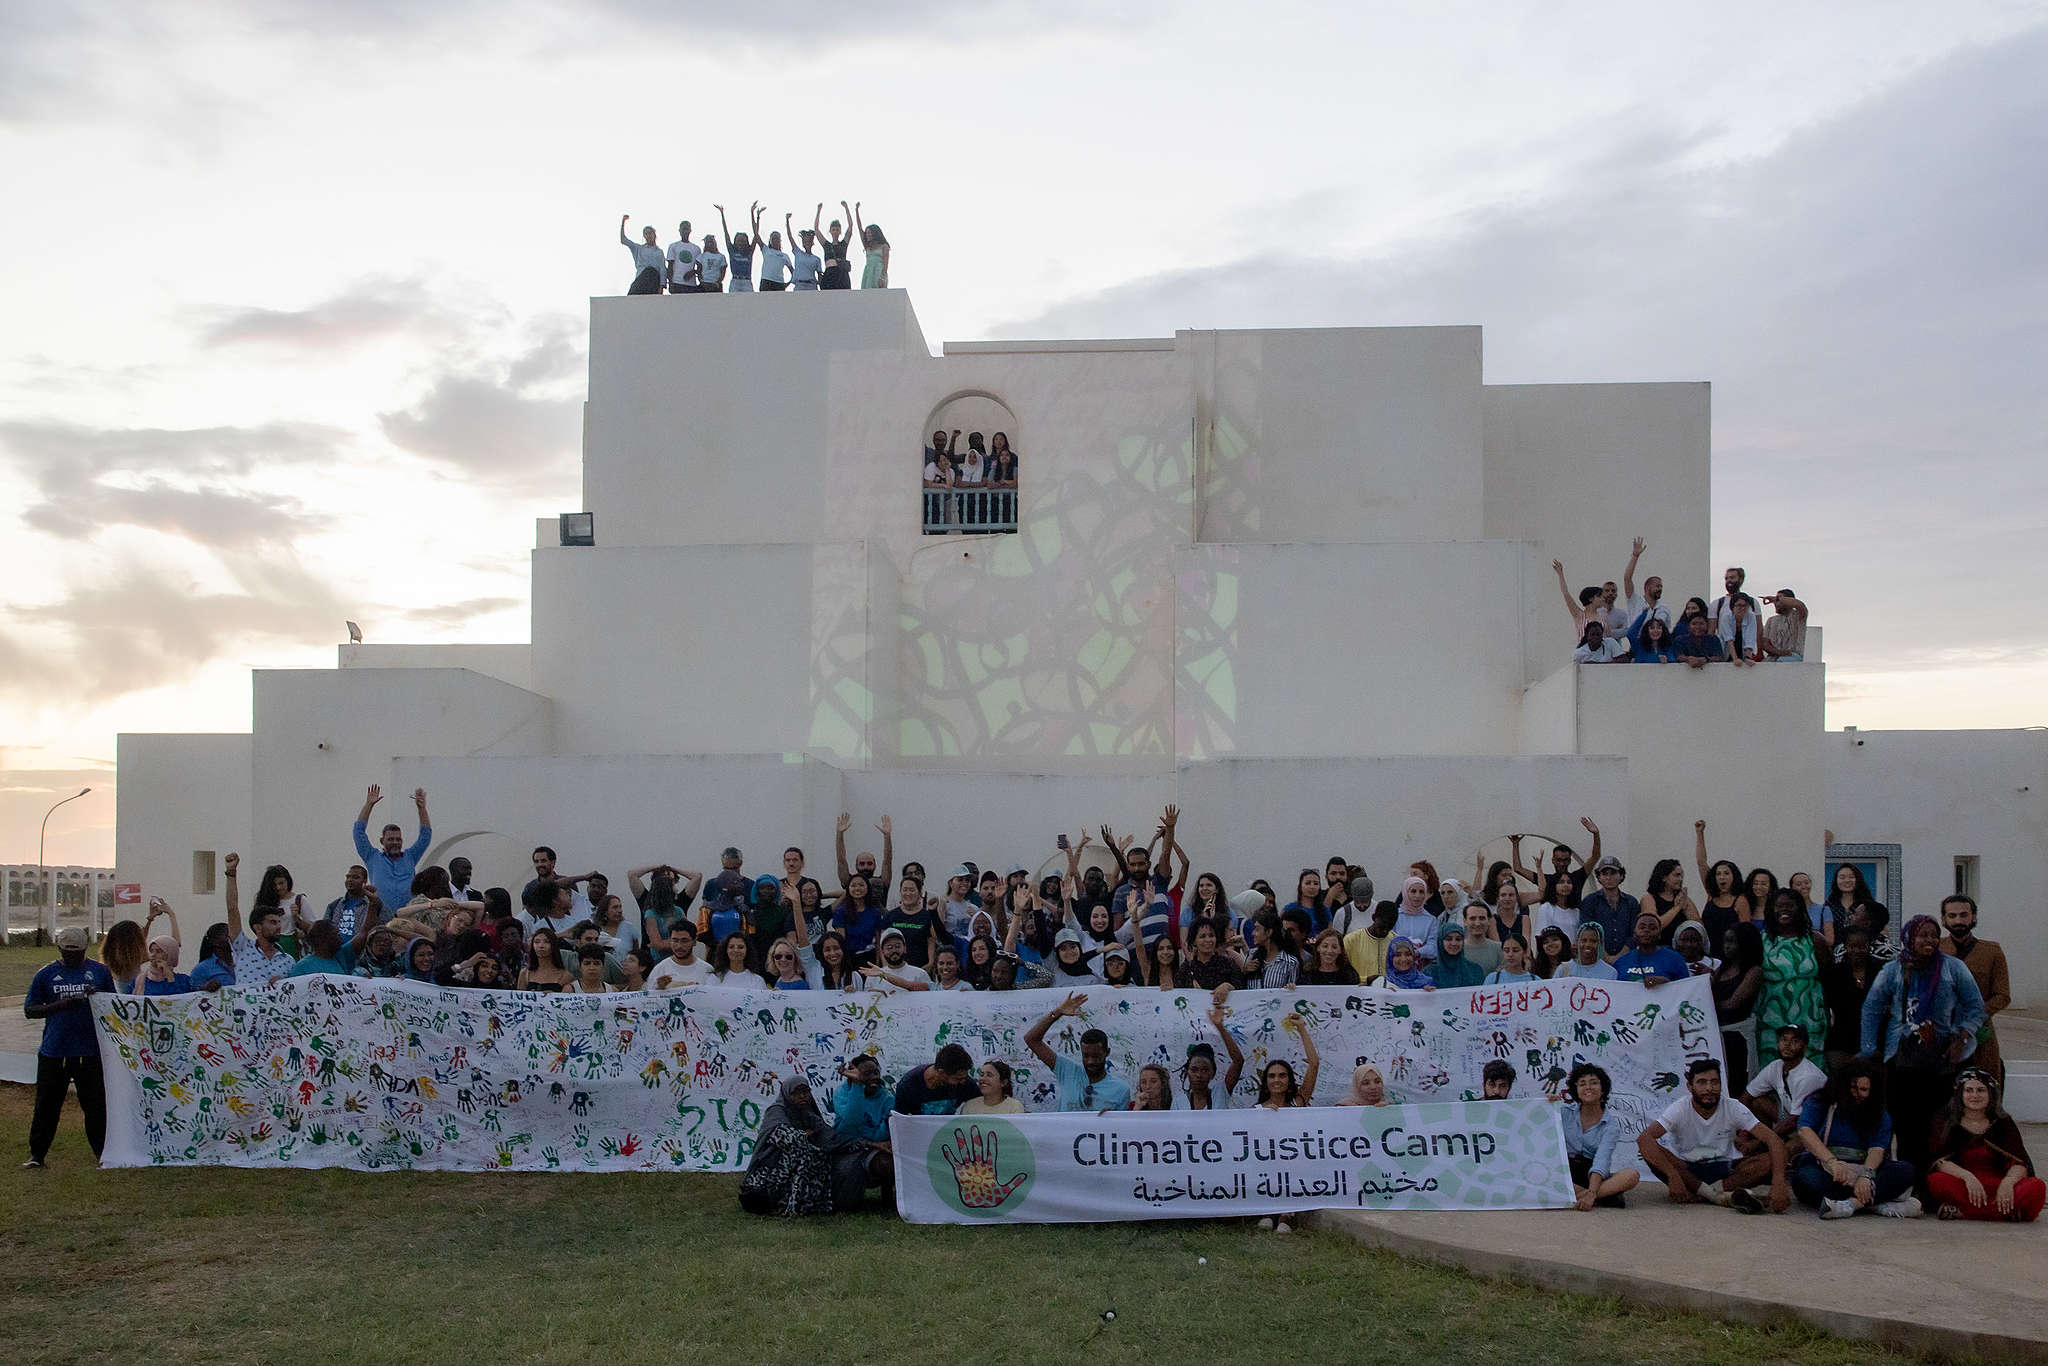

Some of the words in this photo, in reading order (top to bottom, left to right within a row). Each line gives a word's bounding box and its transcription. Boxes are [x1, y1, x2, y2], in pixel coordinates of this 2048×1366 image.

[53, 983, 90, 994] Emirat
[1470, 985, 1554, 1016] GREEN
[112, 997, 161, 1023] VCA
[677, 1095, 760, 1136] STO
[1073, 1132, 1223, 1167] Climate
[1232, 1130, 1372, 1162] Justice
[1380, 1127, 1496, 1164] Camp
[1133, 1172, 1247, 1207] المناخية
[1256, 1170, 1347, 1200] العدالة
[1358, 1170, 1439, 1206] مخيّم
